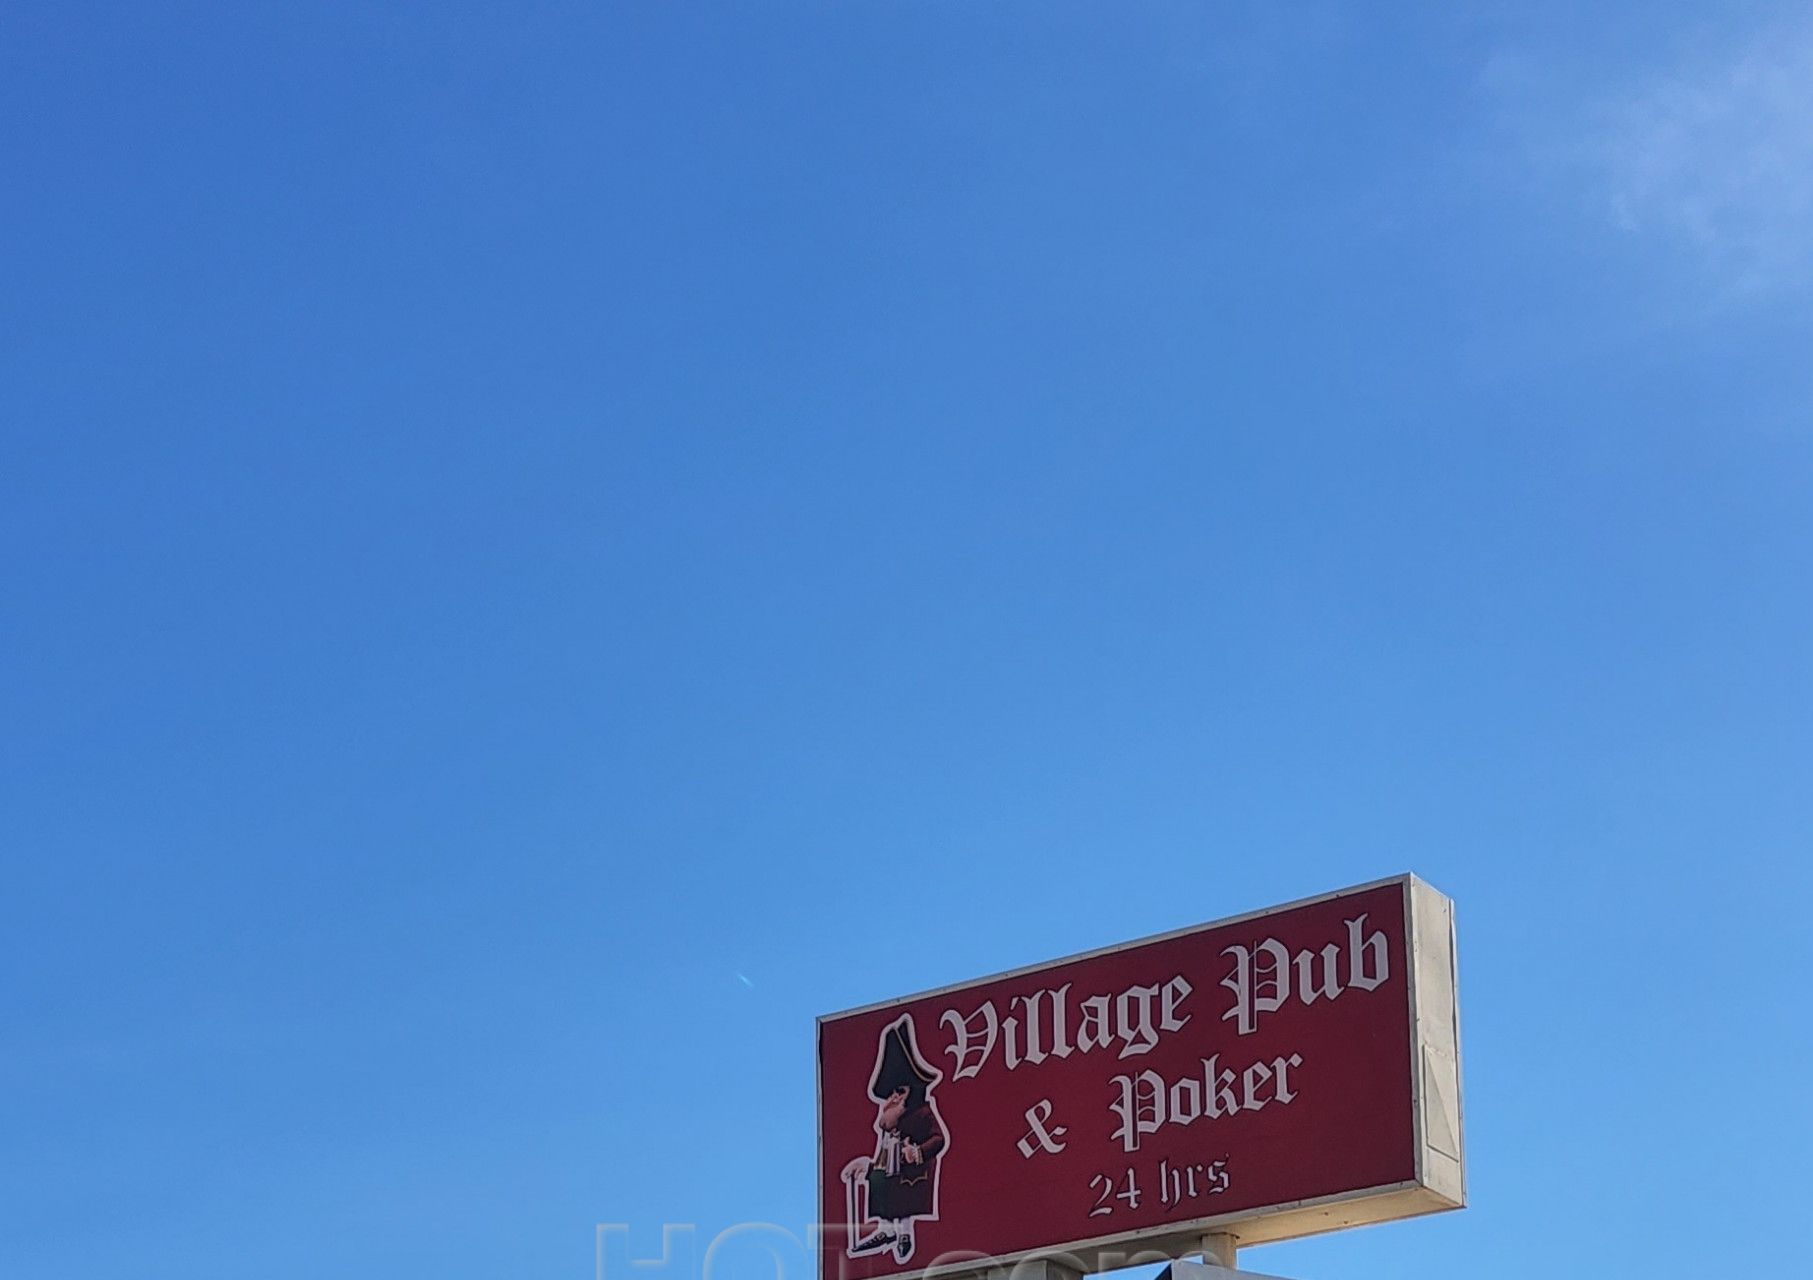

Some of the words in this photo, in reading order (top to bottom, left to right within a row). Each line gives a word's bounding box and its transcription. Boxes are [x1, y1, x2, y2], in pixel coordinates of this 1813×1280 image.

[939, 975, 1194, 1083] Village
[1220, 912, 1390, 1036] Pub
[1016, 1099, 1067, 1159] &
[1108, 1051, 1304, 1152] Poker
[1088, 1171, 1142, 1218] 24
[1160, 1153, 1231, 1211] hrs
